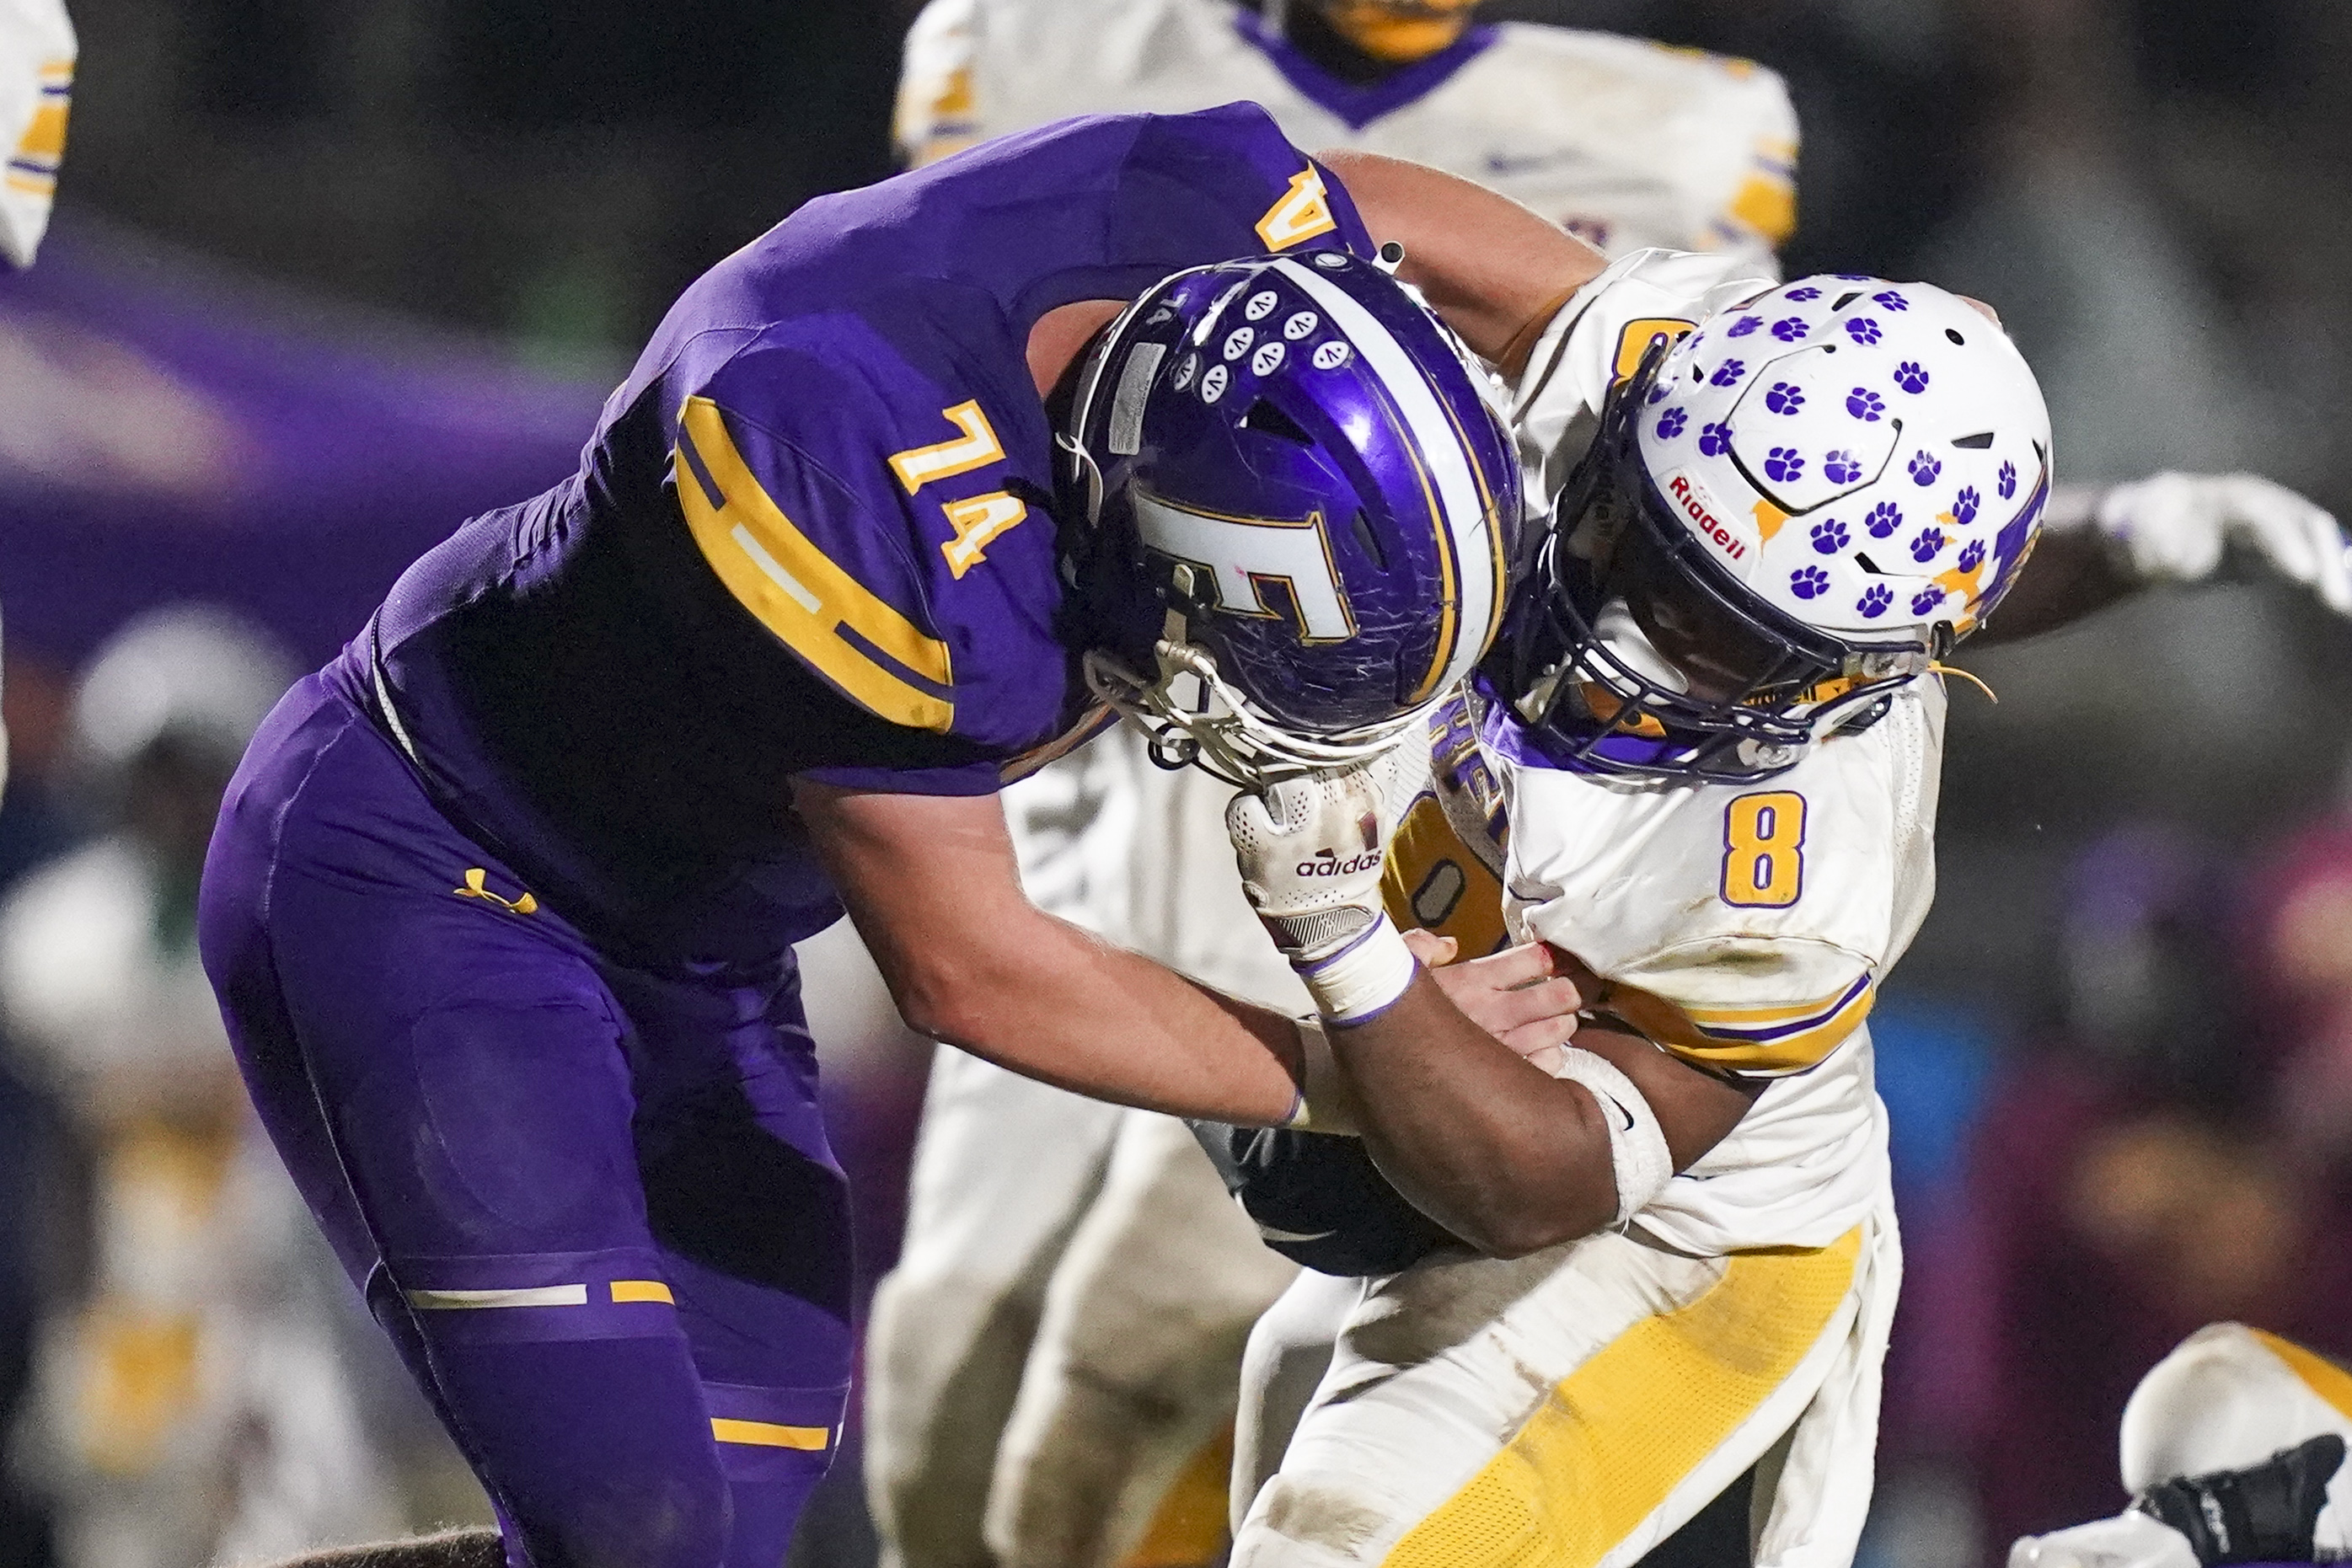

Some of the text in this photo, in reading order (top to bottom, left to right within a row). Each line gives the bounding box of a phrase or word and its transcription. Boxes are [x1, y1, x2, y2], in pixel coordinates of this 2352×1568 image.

[887, 399, 1028, 581] 74
[1295, 849, 1382, 877] adidas
[1719, 789, 1808, 909] 8
